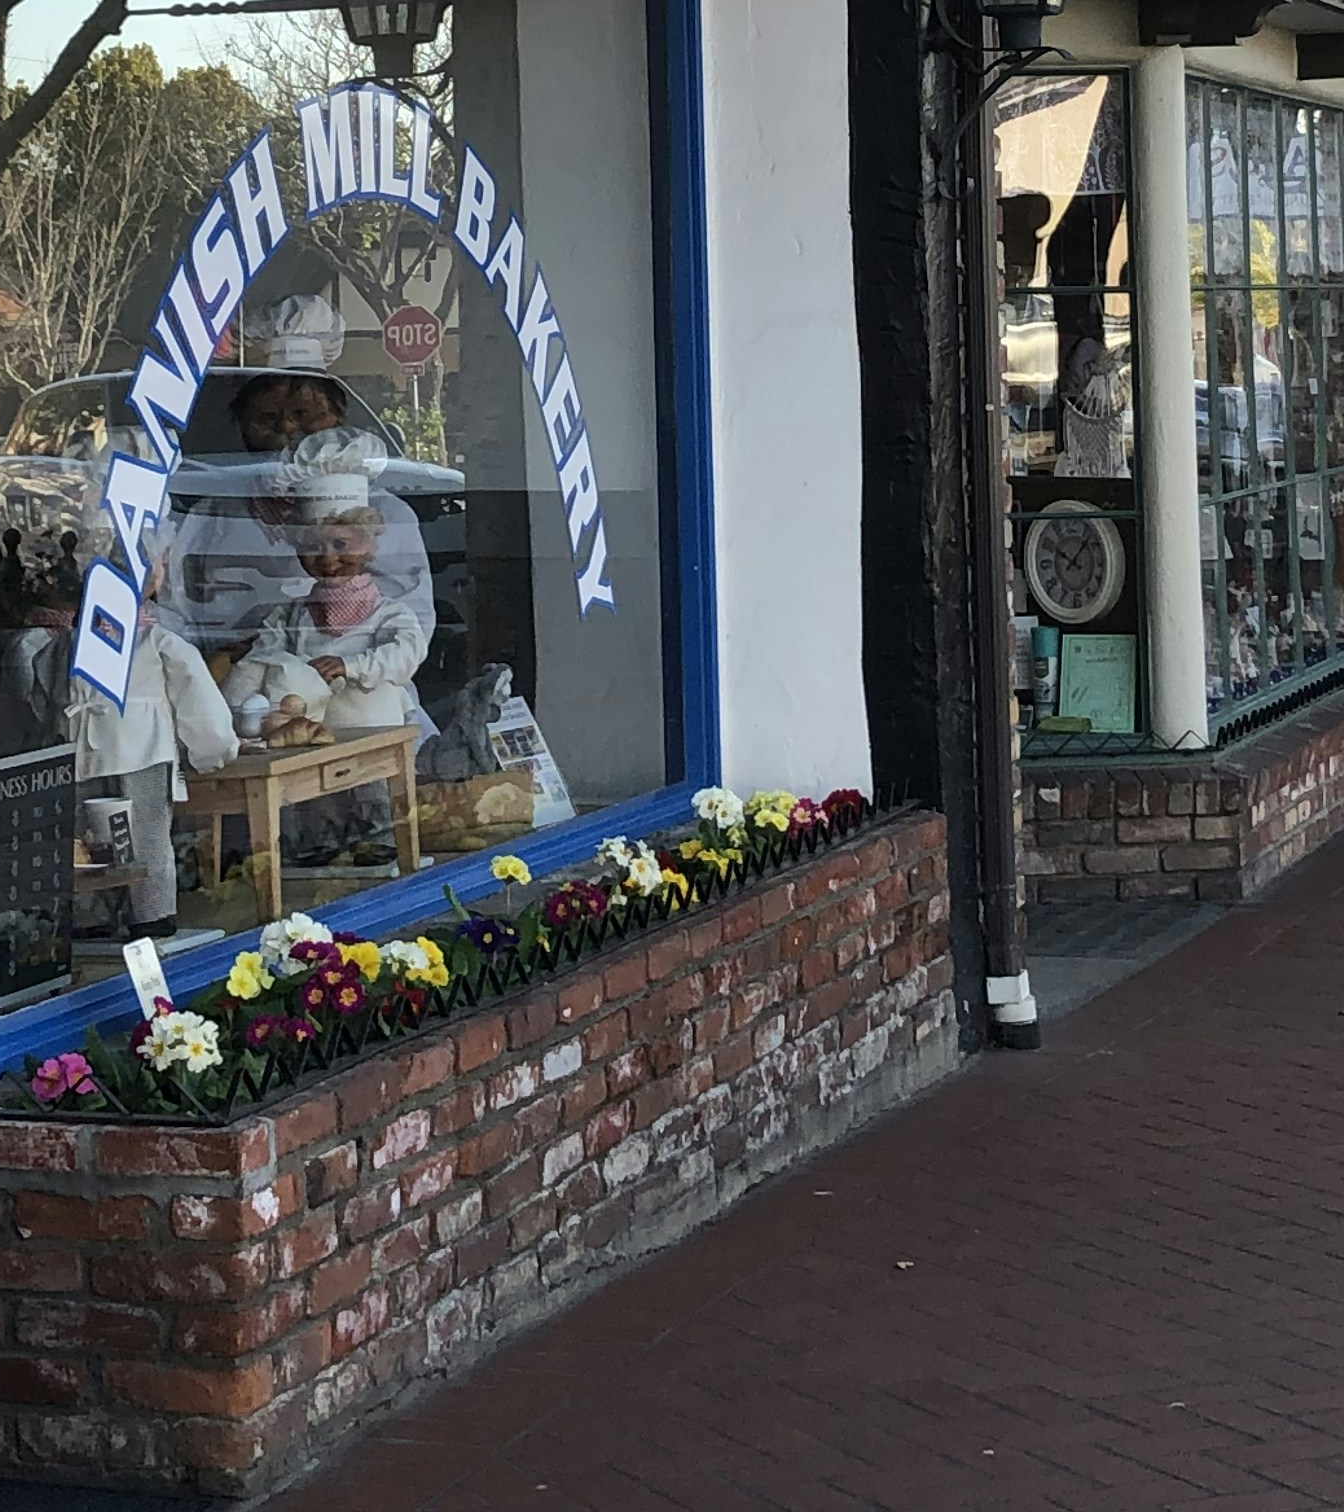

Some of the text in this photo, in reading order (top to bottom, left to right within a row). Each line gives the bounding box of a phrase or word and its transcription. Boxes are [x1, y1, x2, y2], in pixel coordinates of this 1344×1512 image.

[71, 82, 618, 717] DANISH MILL BAKERY
[31, 763, 72, 792] HOURS
